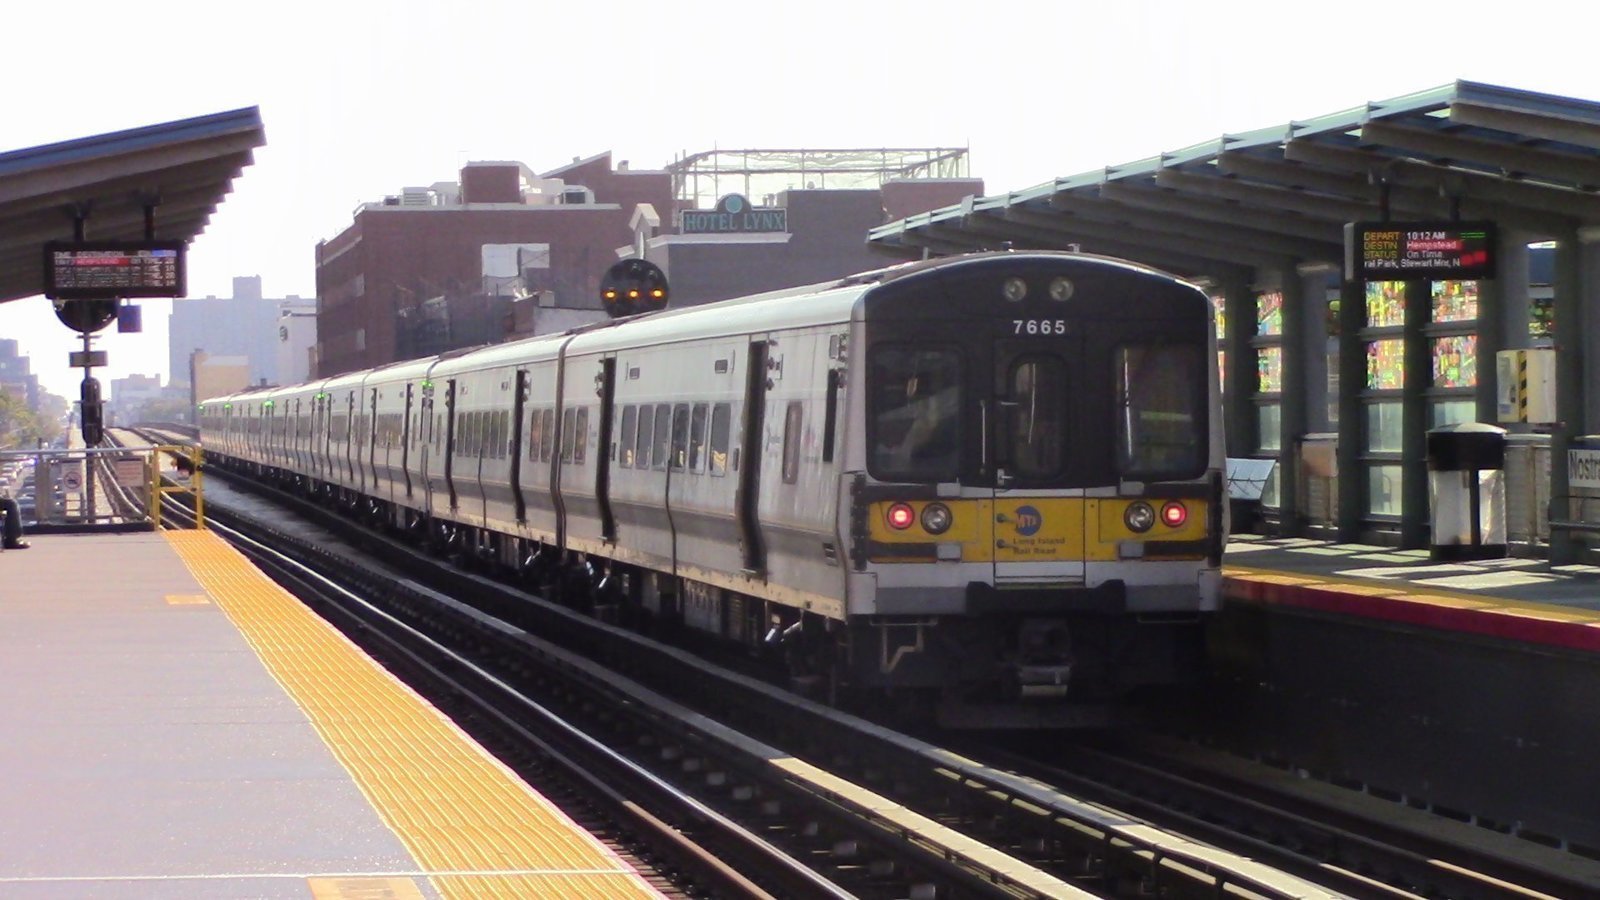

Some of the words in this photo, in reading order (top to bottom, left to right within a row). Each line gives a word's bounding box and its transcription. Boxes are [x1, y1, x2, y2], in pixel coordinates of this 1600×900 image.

[686, 213, 737, 231] HOTEL
[744, 212, 784, 230] LYNX
[1364, 231, 1399, 240] DEPART
[1432, 231, 1446, 240] AM
[1364, 241, 1398, 250] DESTIN
[1407, 240, 1457, 250] Hempstead
[1364, 250, 1398, 259] STATUS
[1407, 250, 1419, 259] On
[1422, 250, 1443, 259] Time
[1013, 319, 1066, 335] 7665
